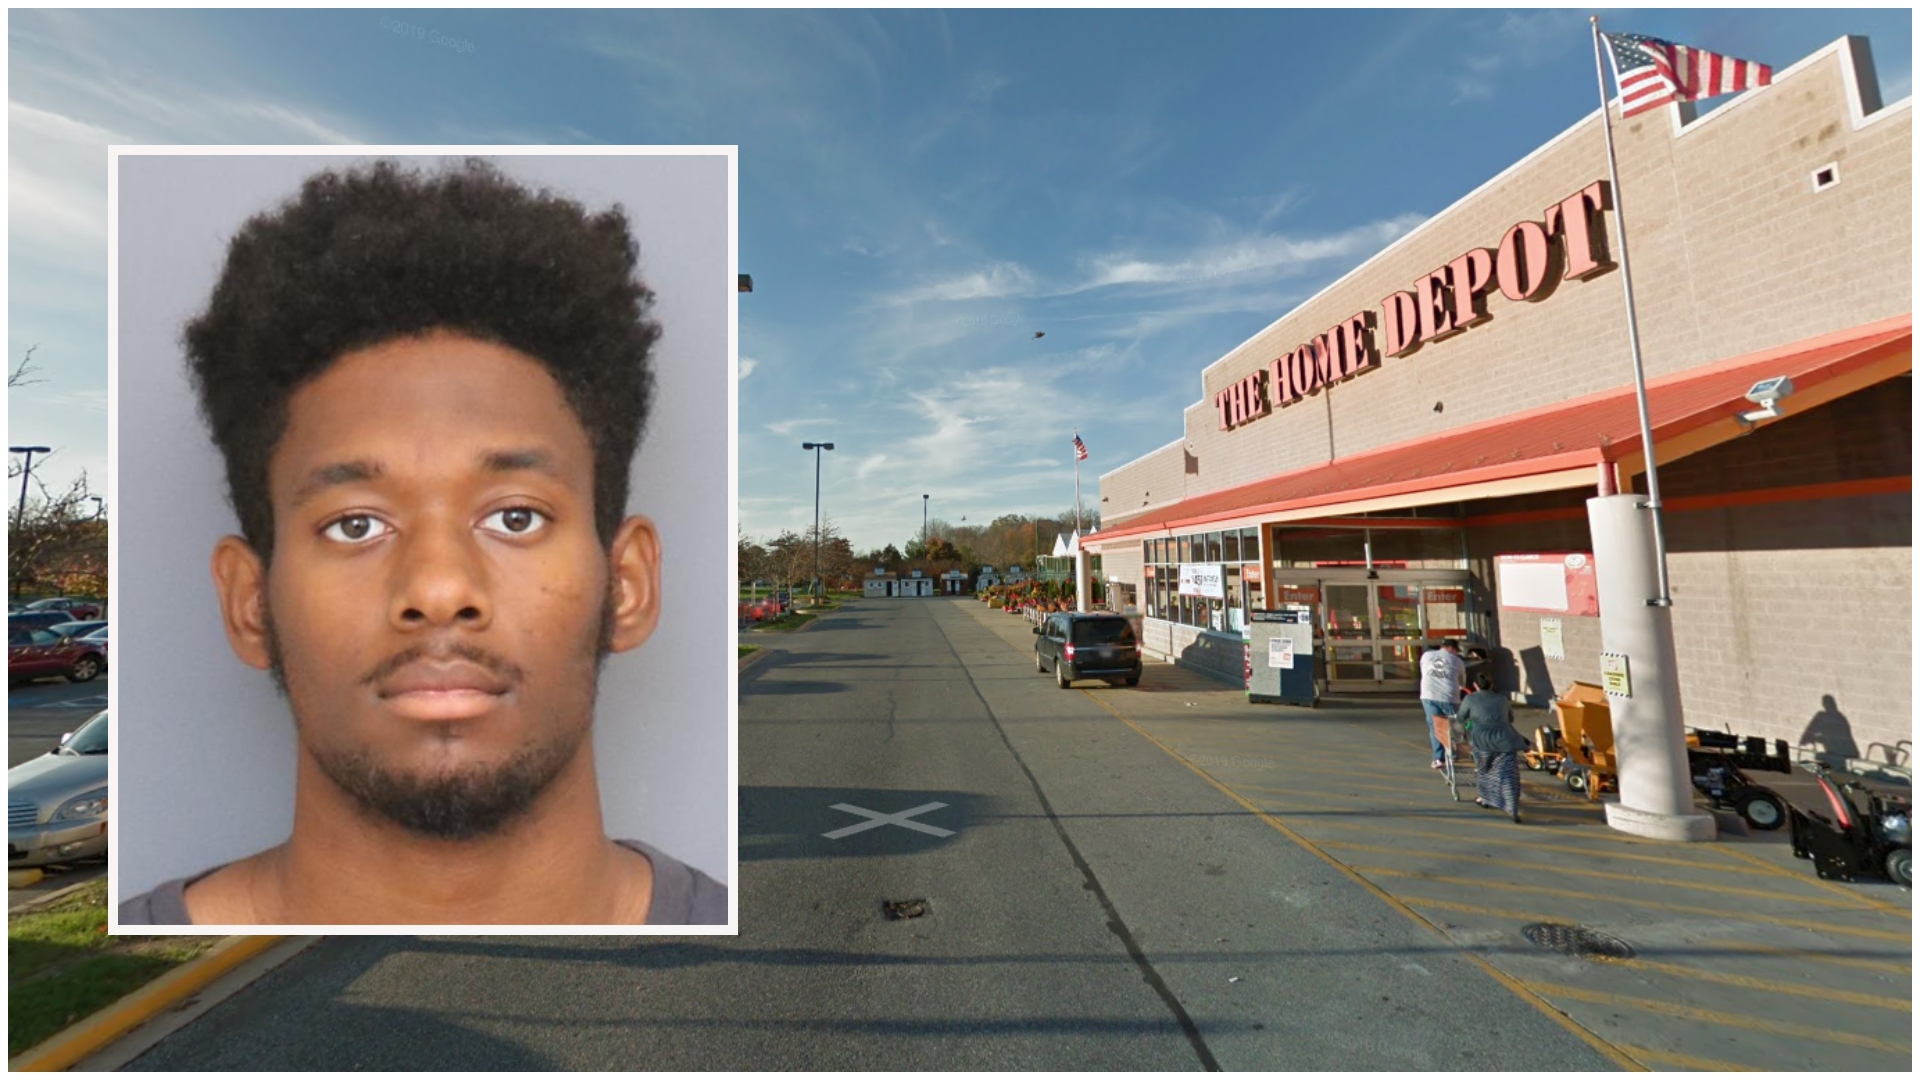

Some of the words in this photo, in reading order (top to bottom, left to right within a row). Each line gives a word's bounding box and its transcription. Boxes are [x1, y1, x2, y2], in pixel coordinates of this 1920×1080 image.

[1214, 369, 1268, 431] THE
[1269, 310, 1378, 408] HOME
[1380, 179, 1616, 359] DEPOT
[1283, 590, 1315, 601] Enter
[1426, 590, 1458, 601] Enter
